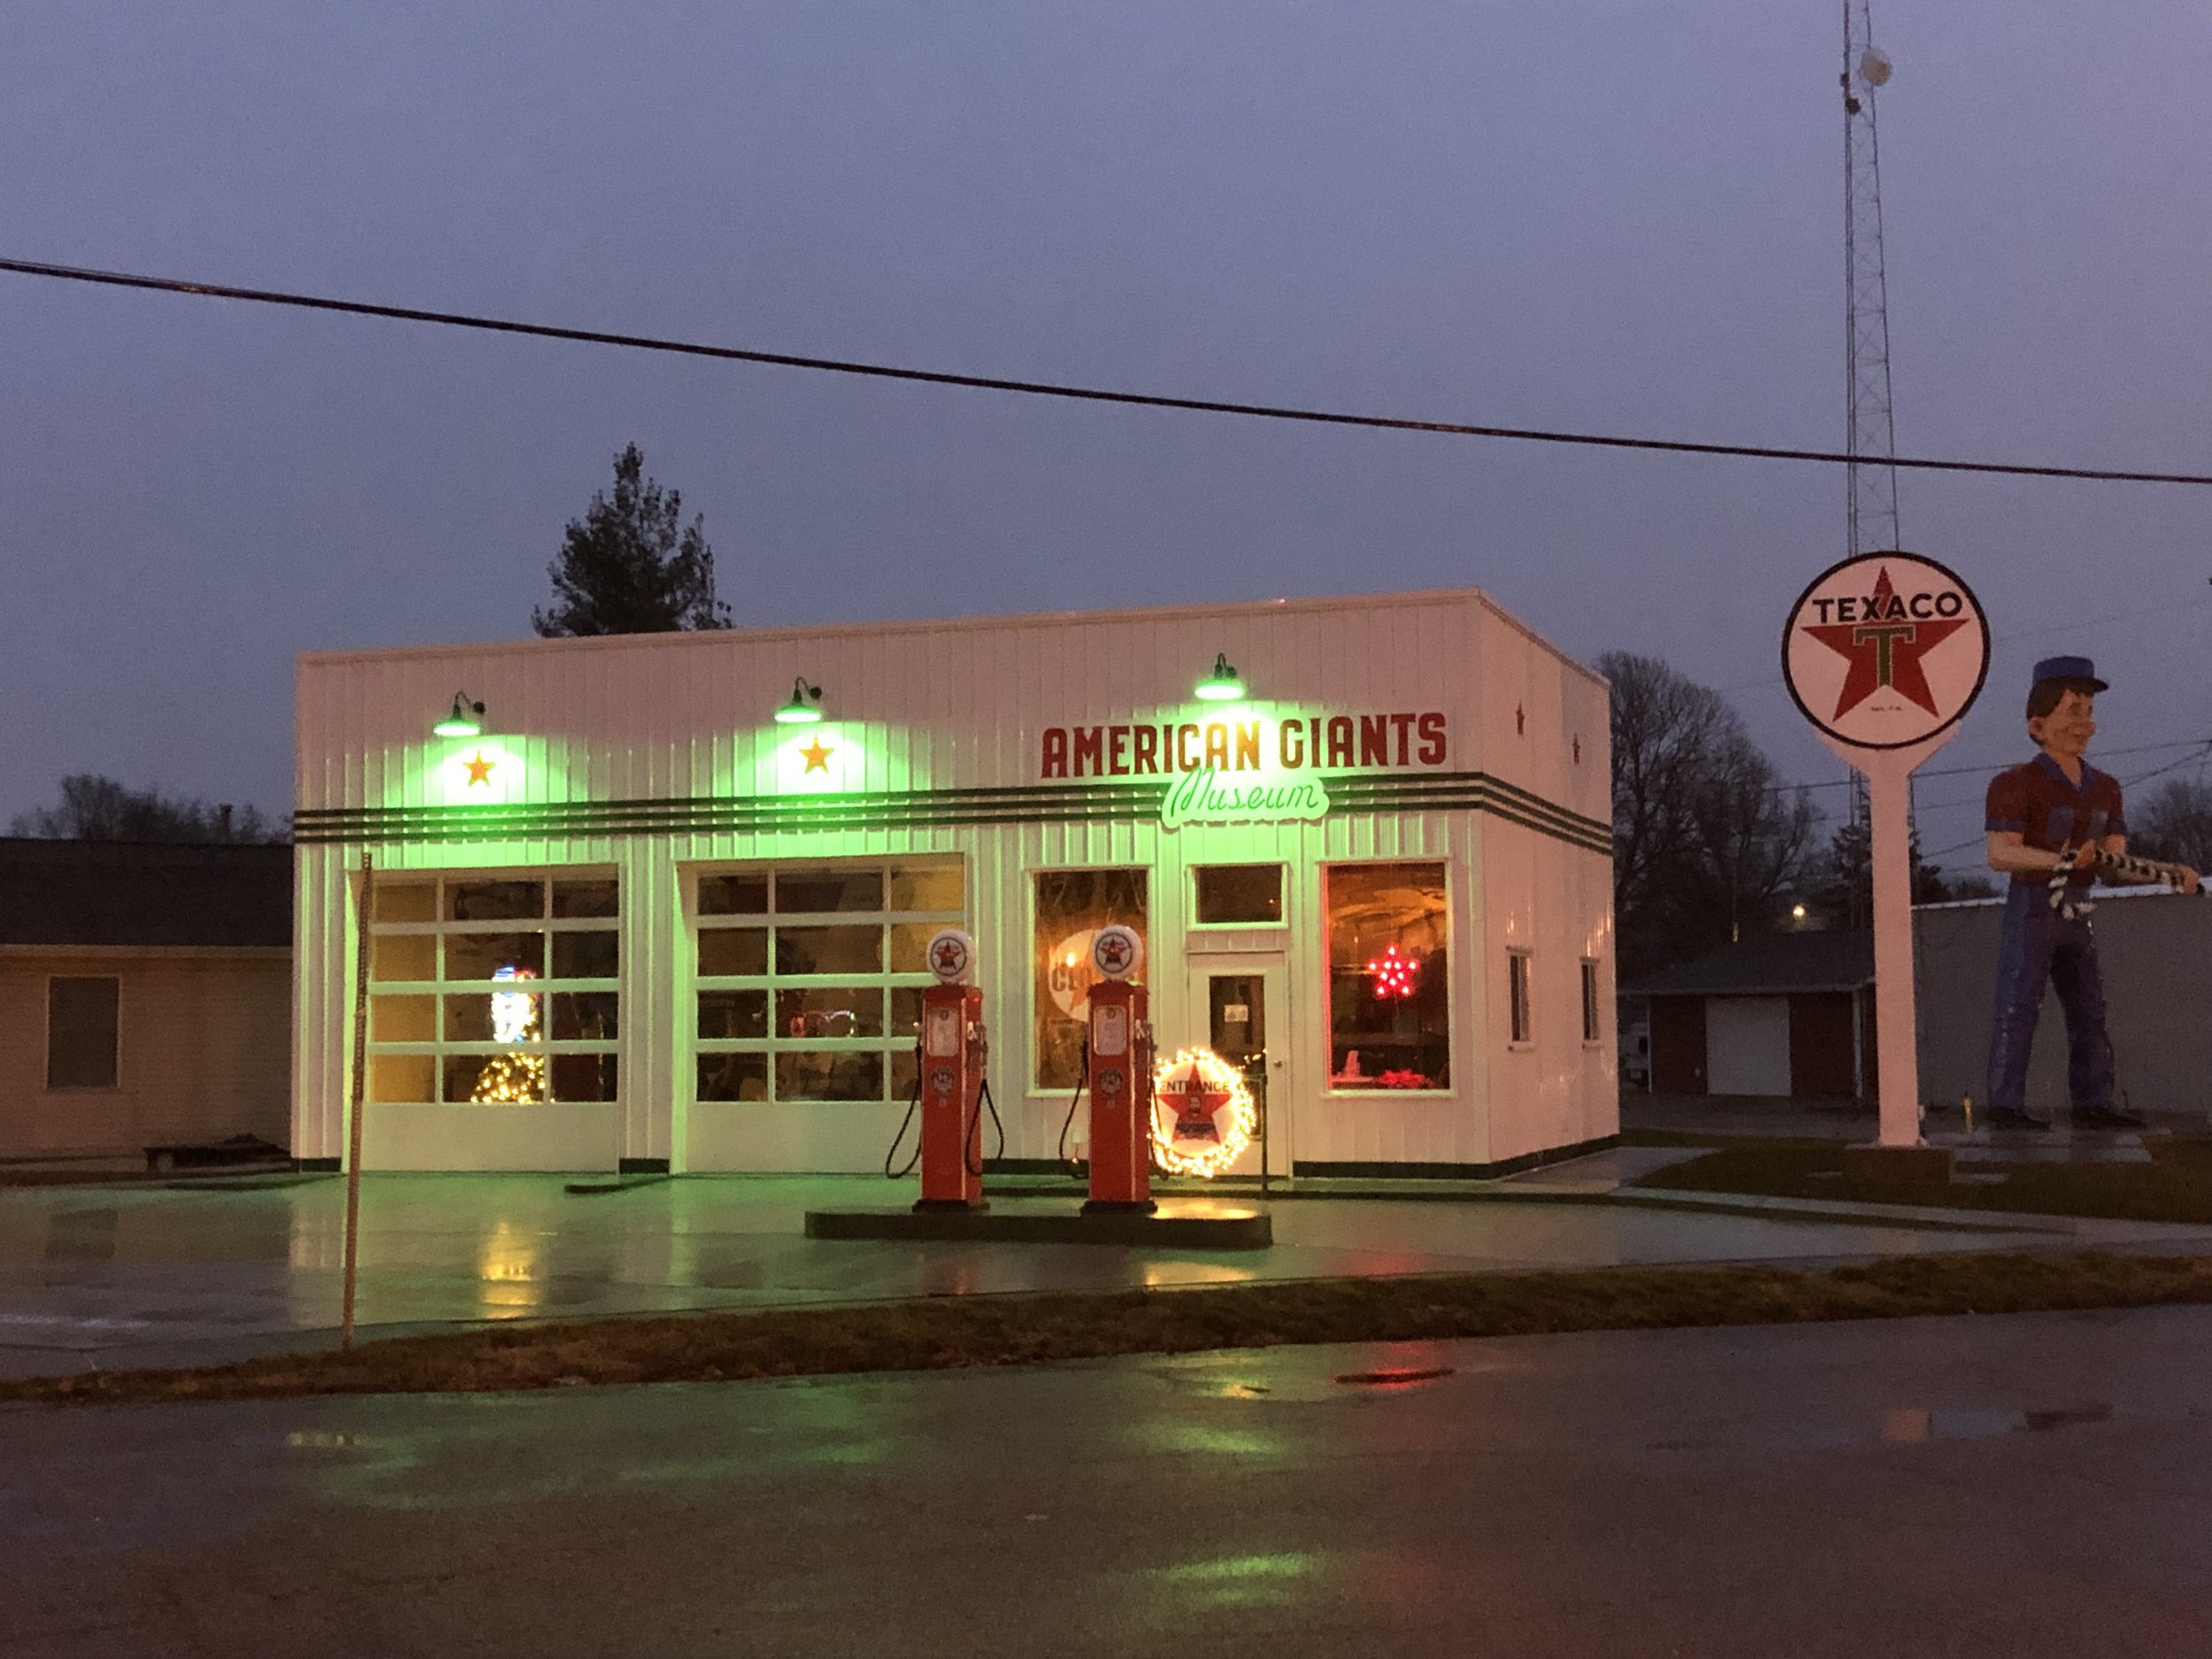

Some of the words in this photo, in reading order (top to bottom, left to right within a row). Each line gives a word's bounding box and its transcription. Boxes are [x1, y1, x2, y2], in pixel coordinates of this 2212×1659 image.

[1812, 592, 1962, 623] TEXACO
[1853, 624, 1916, 687] T
[1041, 720, 1261, 779] AMERICAN
[1279, 712, 1447, 770] GIANTS
[1171, 766, 1318, 818] Museum
[1159, 1080, 1230, 1094] ENTRANCE
